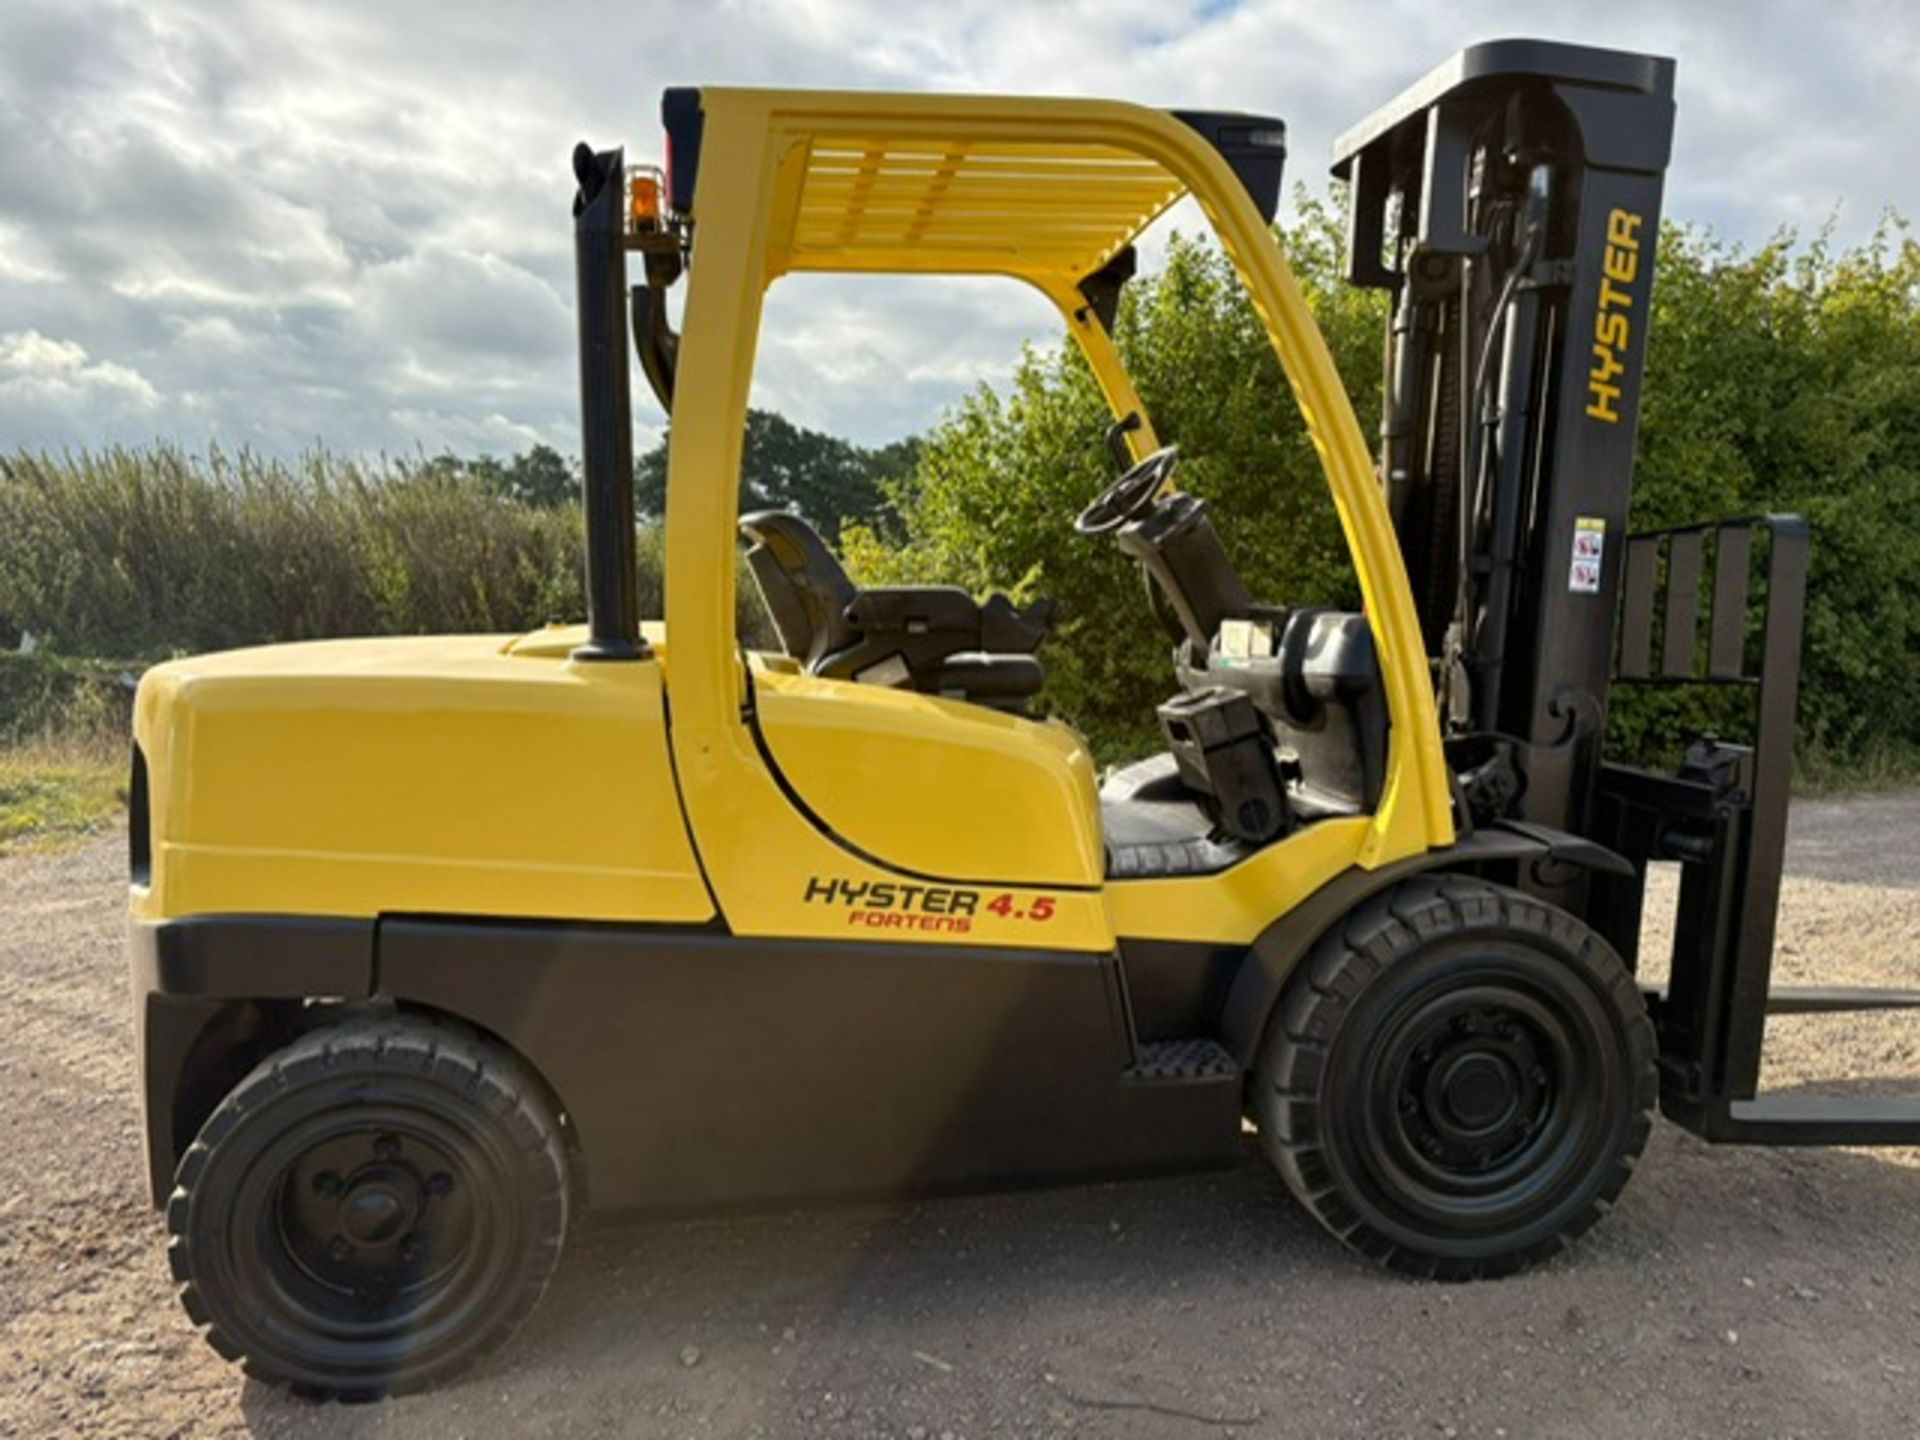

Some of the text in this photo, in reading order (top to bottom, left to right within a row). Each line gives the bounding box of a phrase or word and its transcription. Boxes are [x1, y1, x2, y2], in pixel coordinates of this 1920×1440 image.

[1585, 208, 1643, 424] HYSTER
[804, 877, 1056, 921] HYSTER 4.5
[849, 910, 973, 933] FORTENS
